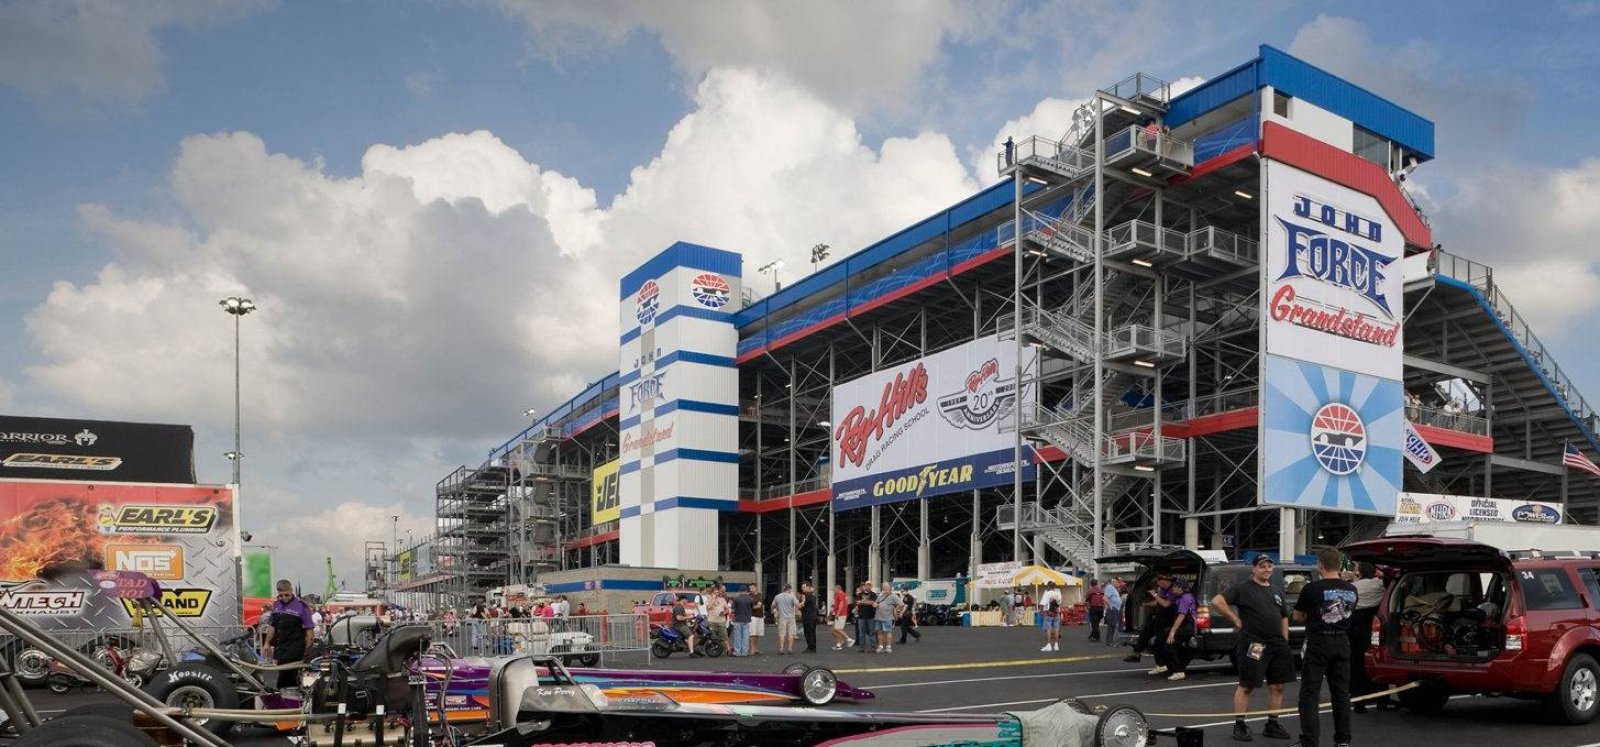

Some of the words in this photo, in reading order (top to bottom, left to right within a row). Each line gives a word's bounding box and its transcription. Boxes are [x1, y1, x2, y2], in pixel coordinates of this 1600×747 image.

[1293, 196, 1382, 243] JOHN
[1273, 214, 1399, 320] FORCE
[1270, 284, 1400, 348] Grandstand
[633, 347, 662, 369] JOHN
[628, 371, 668, 415] FORCE
[874, 361, 930, 442] Hill's
[0, 432, 73, 443] ARRIOR
[621, 421, 675, 454] Grandstand
[865, 450, 881, 471] DRAG
[881, 428, 903, 452] RACING
[903, 406, 929, 431] SCHOOL
[10, 455, 114, 465] EARL'S
[597, 471, 620, 513] JE
[873, 464, 974, 497] GOODYEAR
[120, 508, 210, 525] EARL'S
[1428, 503, 1453, 520] NHRA
[1469, 508, 1498, 517] LICENSED
[1470, 500, 1498, 509] OFFICIAL
[116, 550, 177, 571] NOS
[168, 670, 213, 684] Hoosier
